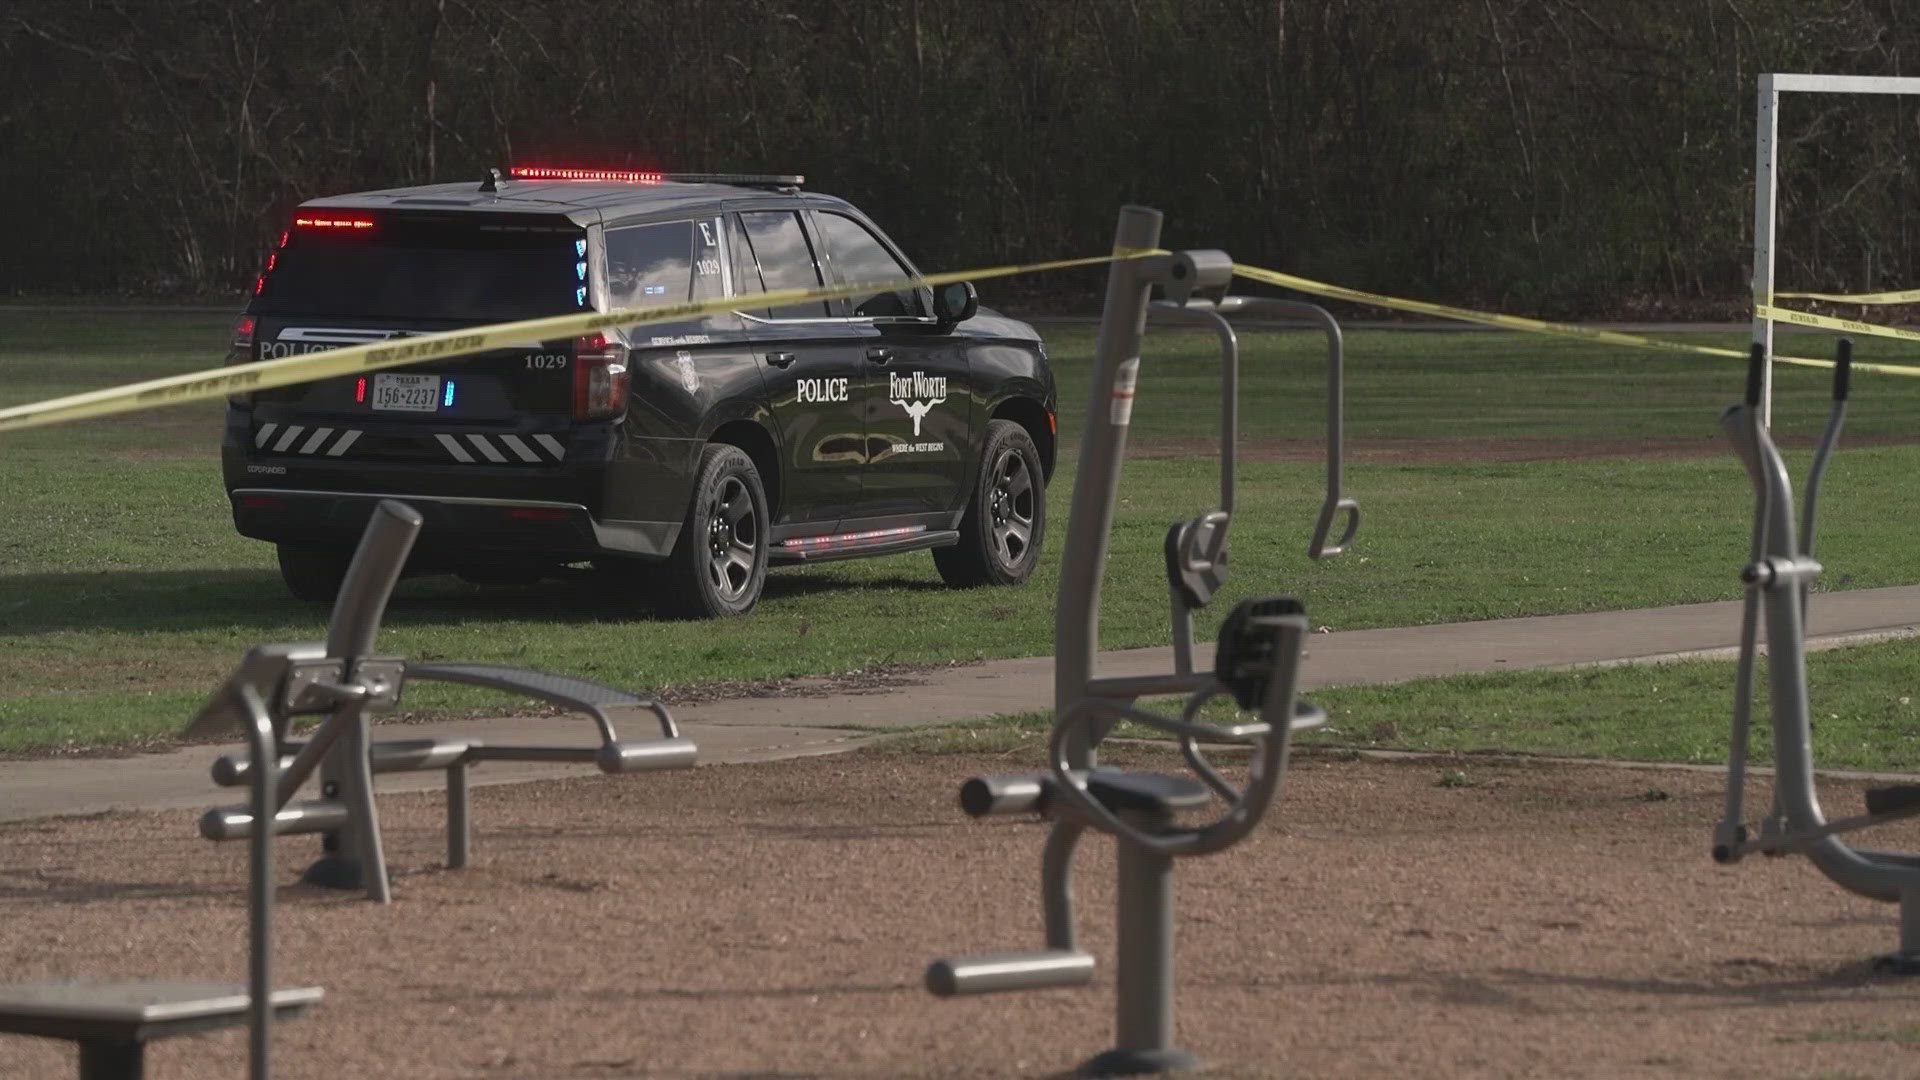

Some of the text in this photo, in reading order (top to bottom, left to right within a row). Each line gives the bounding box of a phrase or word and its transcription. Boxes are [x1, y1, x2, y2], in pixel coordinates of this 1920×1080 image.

[699, 223, 716, 246] E
[696, 260, 720, 275] 1029
[260, 341, 338, 361] POLI
[525, 355, 567, 369] 1029
[797, 378, 848, 402] POLICE
[890, 371, 947, 398] FORT WORTH
[915, 443, 928, 452] WEST
